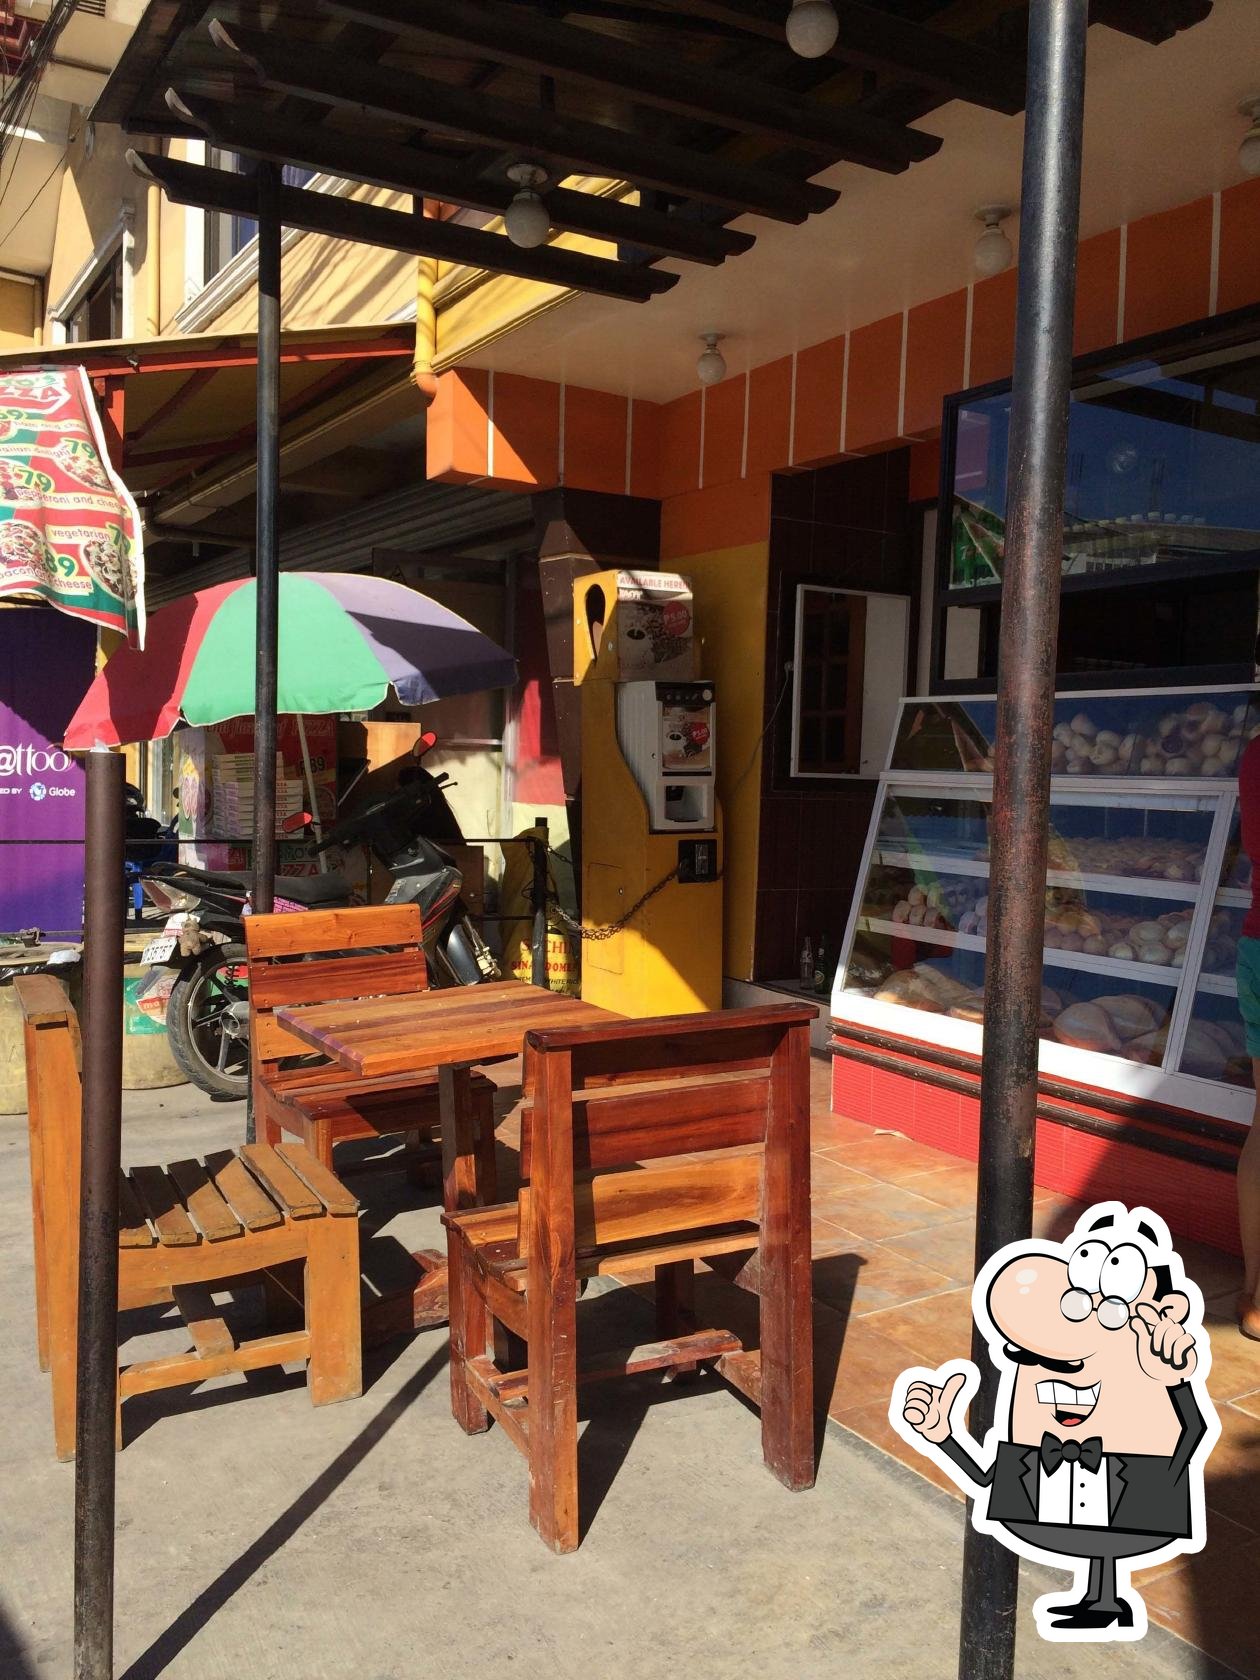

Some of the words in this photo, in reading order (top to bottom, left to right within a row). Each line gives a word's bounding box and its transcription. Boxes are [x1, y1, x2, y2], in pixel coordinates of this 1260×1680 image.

[63, 439, 96, 459] 79
[18, 469, 52, 492] 79
[73, 495, 94, 505] and
[51, 528, 111, 540] vegetarian
[619, 575, 662, 588] AVAILABLE
[49, 787, 76, 797] Globe
